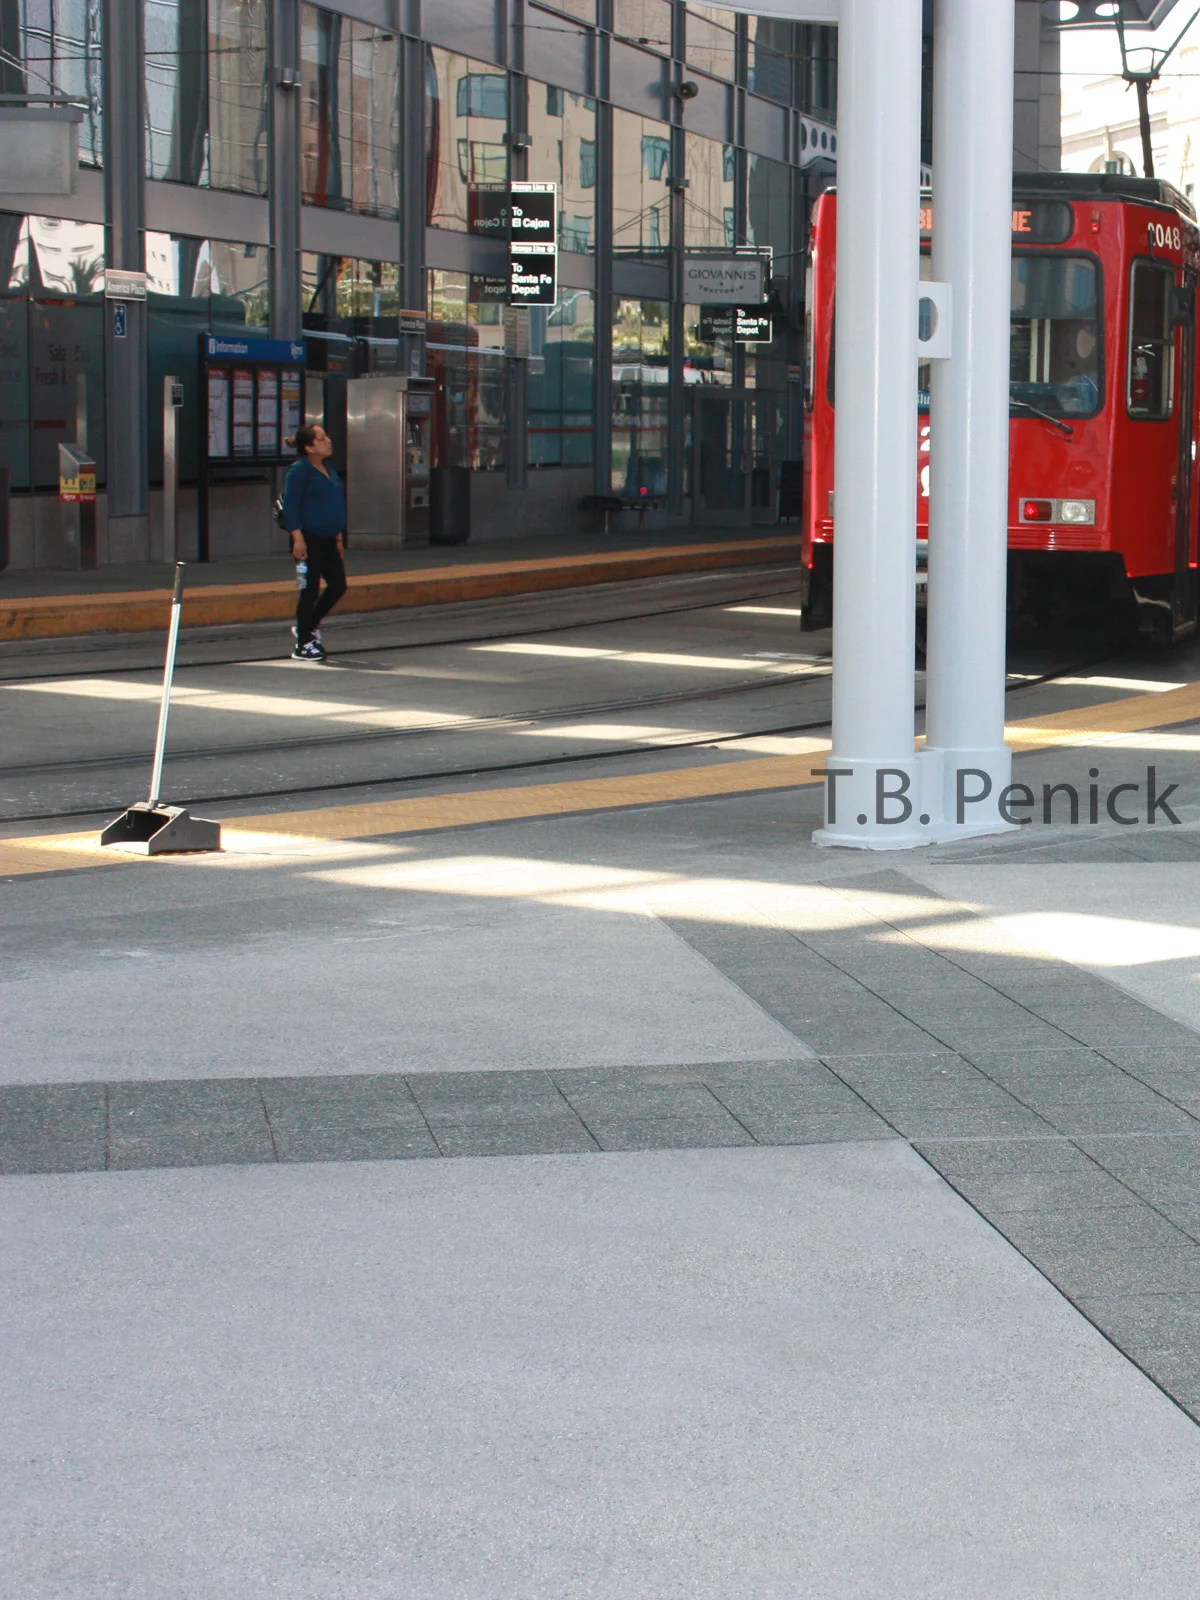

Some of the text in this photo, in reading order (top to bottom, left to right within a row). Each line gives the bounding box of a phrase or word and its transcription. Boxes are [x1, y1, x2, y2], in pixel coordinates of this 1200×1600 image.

[512, 206, 523, 216] To
[512, 218, 550, 229] El Cajon
[512, 263, 523, 273] To
[512, 274, 552, 284] Santa Fe
[688, 269, 756, 280] GIOVANNI'S
[512, 285, 540, 296] Depot
[737, 309, 746, 317] To
[737, 318, 768, 326] Santa Fe
[737, 326, 759, 335] Depot
